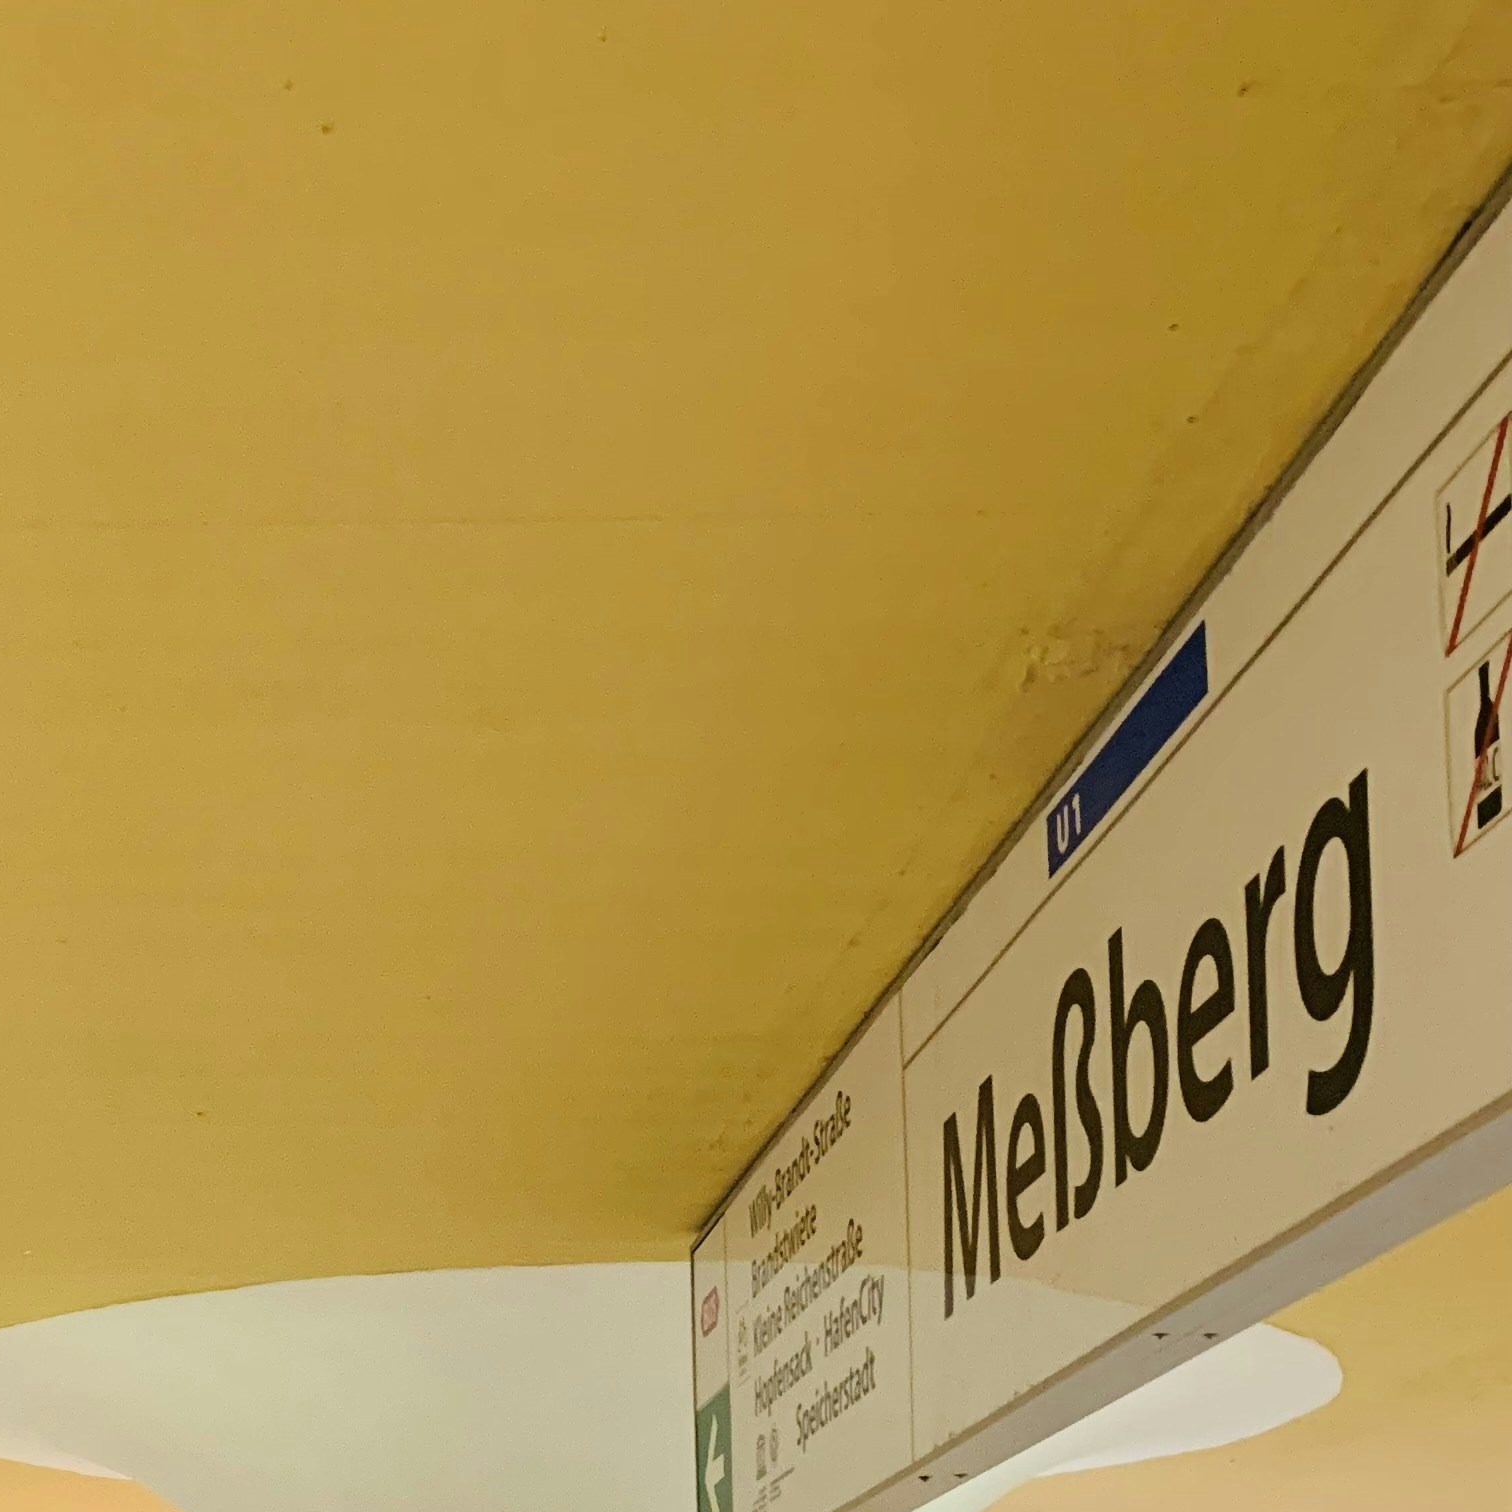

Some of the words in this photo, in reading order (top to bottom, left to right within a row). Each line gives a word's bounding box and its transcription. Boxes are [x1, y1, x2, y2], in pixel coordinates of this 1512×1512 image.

[1056, 792, 1081, 854] U1
[943, 768, 1374, 1320] Meßberg
[749, 1090, 851, 1239] Willy-Brandt-Straße
[751, 1203, 817, 1298] Brandstwiete
[753, 1304, 783, 1358] Kleine
[783, 1217, 863, 1328] Reichenstraße
[754, 1330, 813, 1417] Hopfensack
[823, 1273, 885, 1358] HafenCity
[796, 1346, 876, 1454] Speicherstadt
